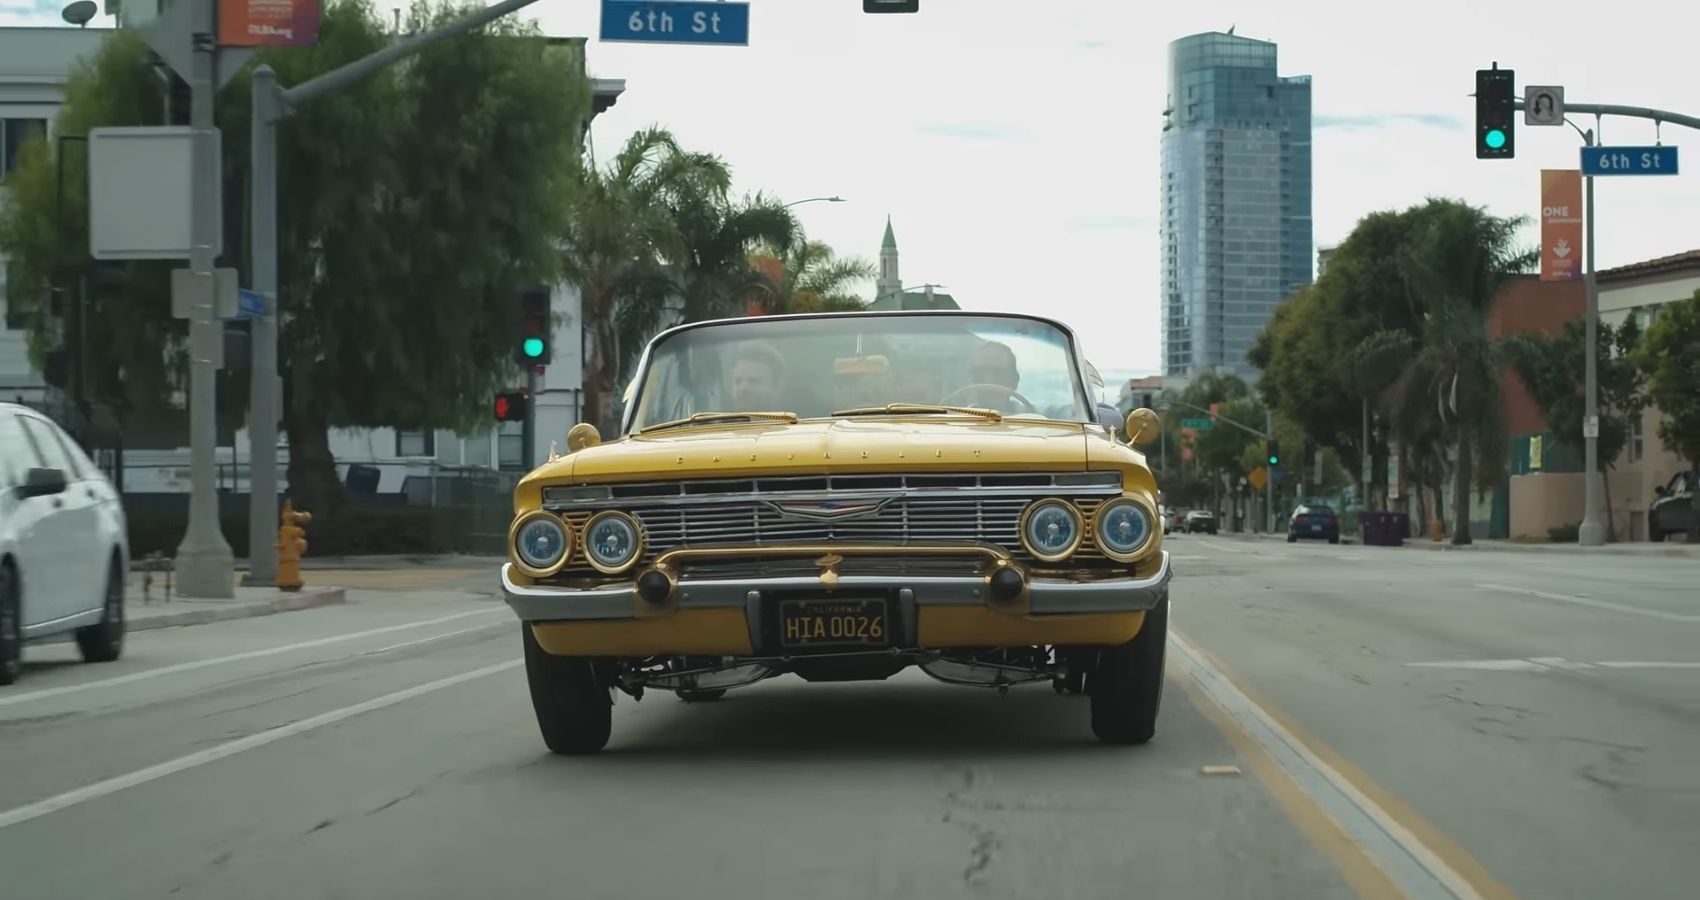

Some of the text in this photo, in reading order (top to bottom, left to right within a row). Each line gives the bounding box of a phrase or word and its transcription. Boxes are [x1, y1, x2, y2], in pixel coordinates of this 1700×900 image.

[628, 11, 721, 34] 6th St
[1599, 153, 1661, 169] 6th St
[1542, 206, 1569, 217] ONE
[786, 615, 883, 639] HIA 0026
